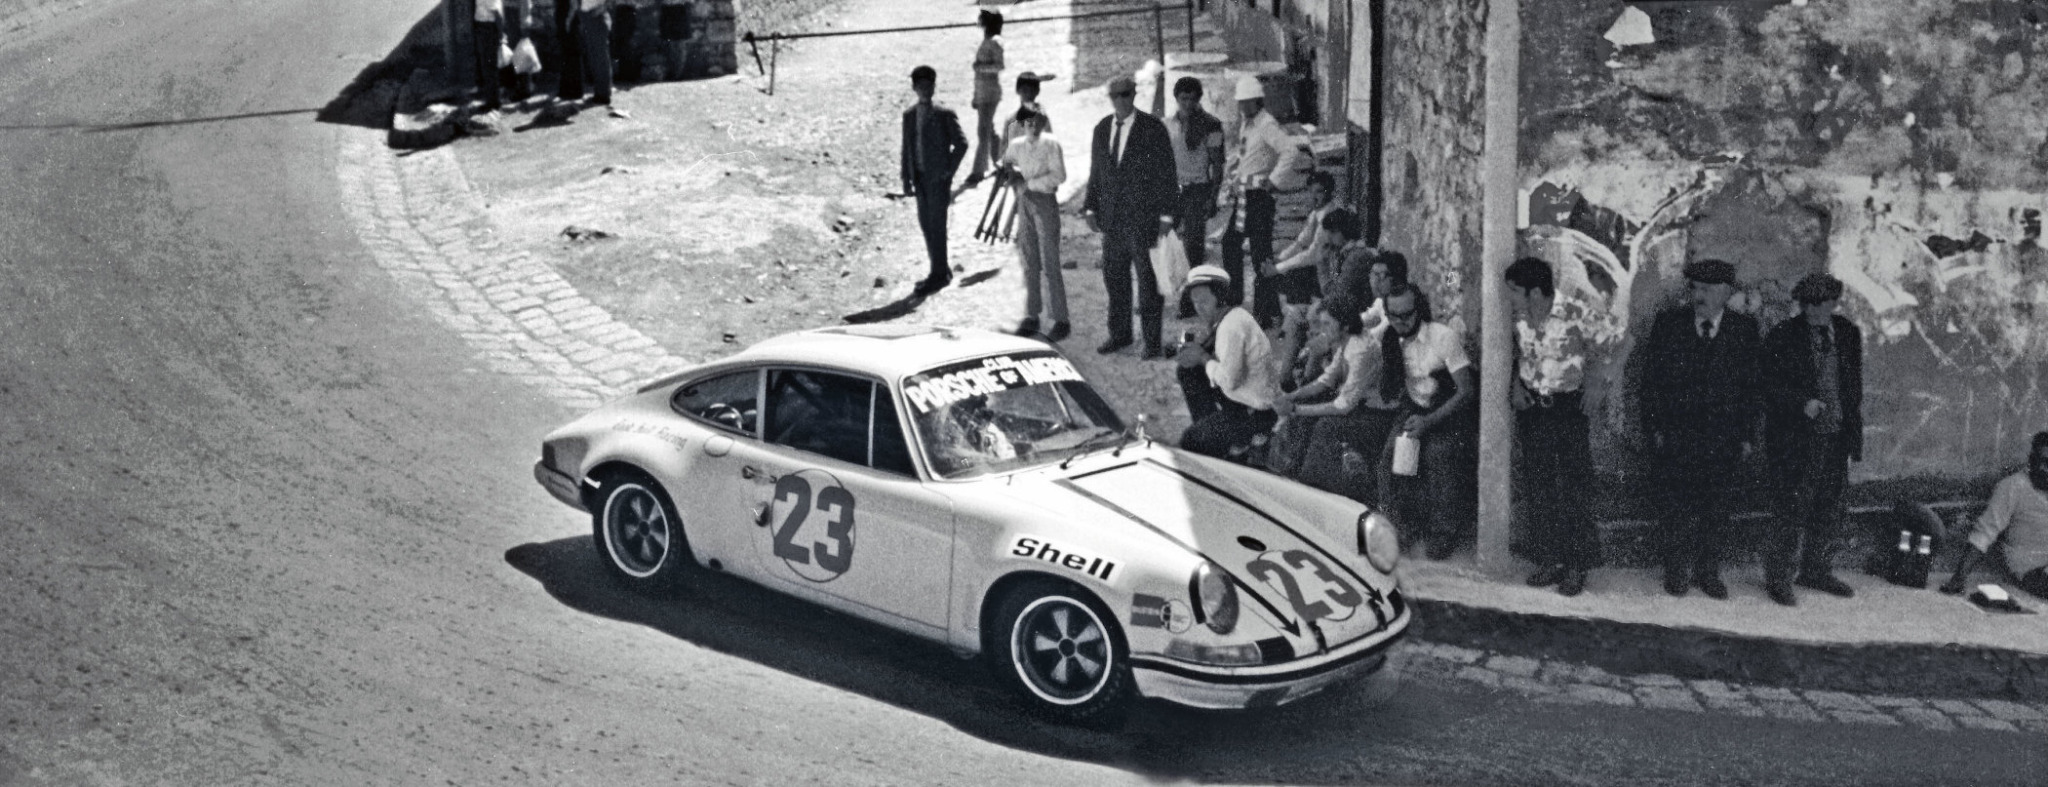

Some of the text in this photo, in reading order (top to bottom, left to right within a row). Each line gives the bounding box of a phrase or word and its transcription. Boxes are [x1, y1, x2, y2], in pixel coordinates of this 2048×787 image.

[904, 366, 1007, 414] PORSCHE
[773, 474, 855, 574] 23
[1012, 537, 1115, 580] Shell
[1246, 550, 1363, 622] 23
